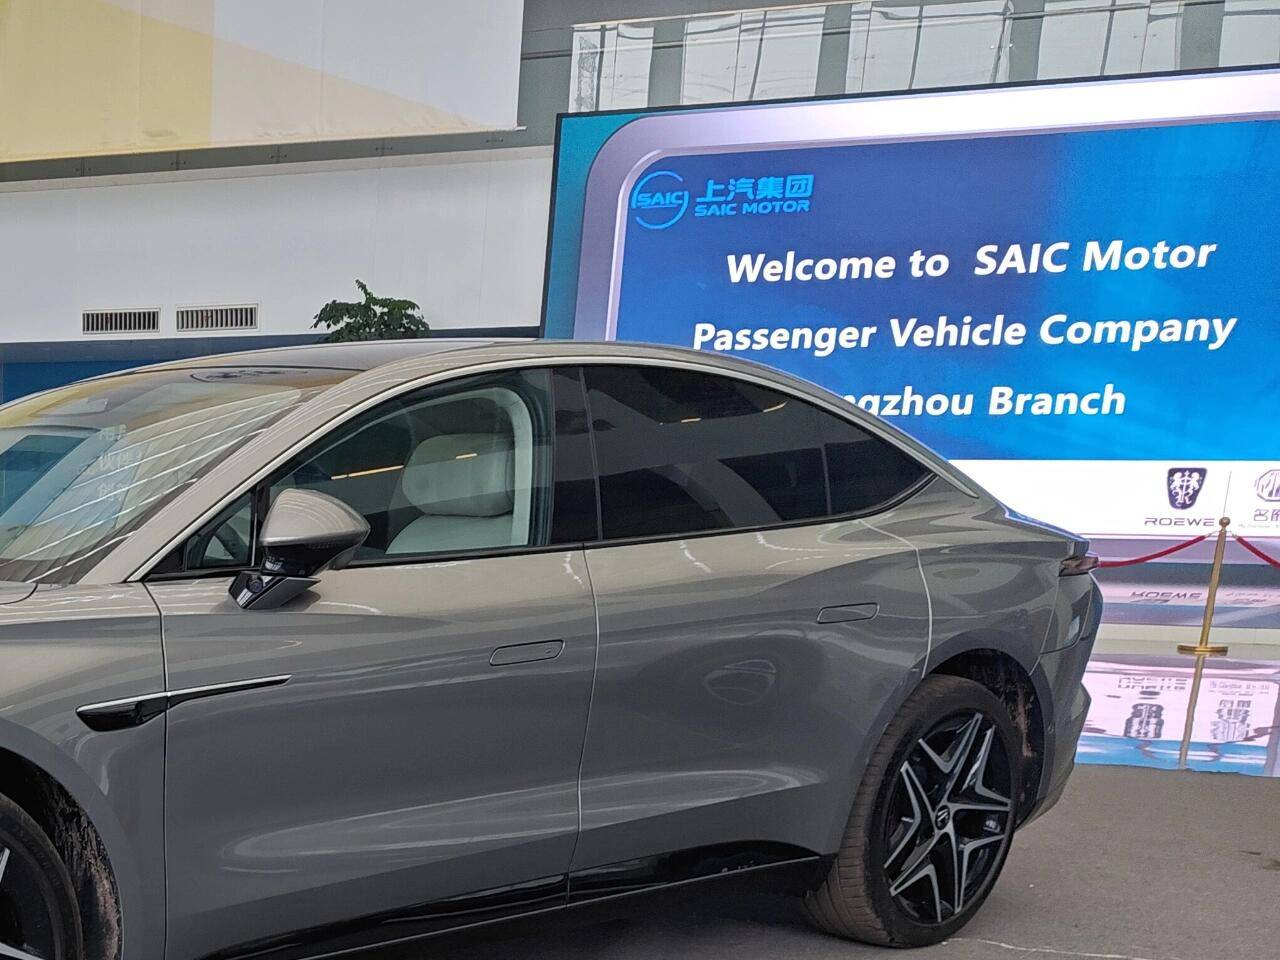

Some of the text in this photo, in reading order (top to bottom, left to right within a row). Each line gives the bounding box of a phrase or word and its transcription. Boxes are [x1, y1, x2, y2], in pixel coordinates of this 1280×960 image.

[637, 191, 685, 206] SAIC
[696, 174, 814, 202] 上汽集团
[695, 199, 811, 217] SAIC MOTOR
[726, 239, 1218, 284] Welcome to SAIC Motor
[693, 313, 1238, 357] Passenger Vehicle Company
[987, 383, 1127, 416] Branch
[1144, 517, 1215, 527] ROEWE
